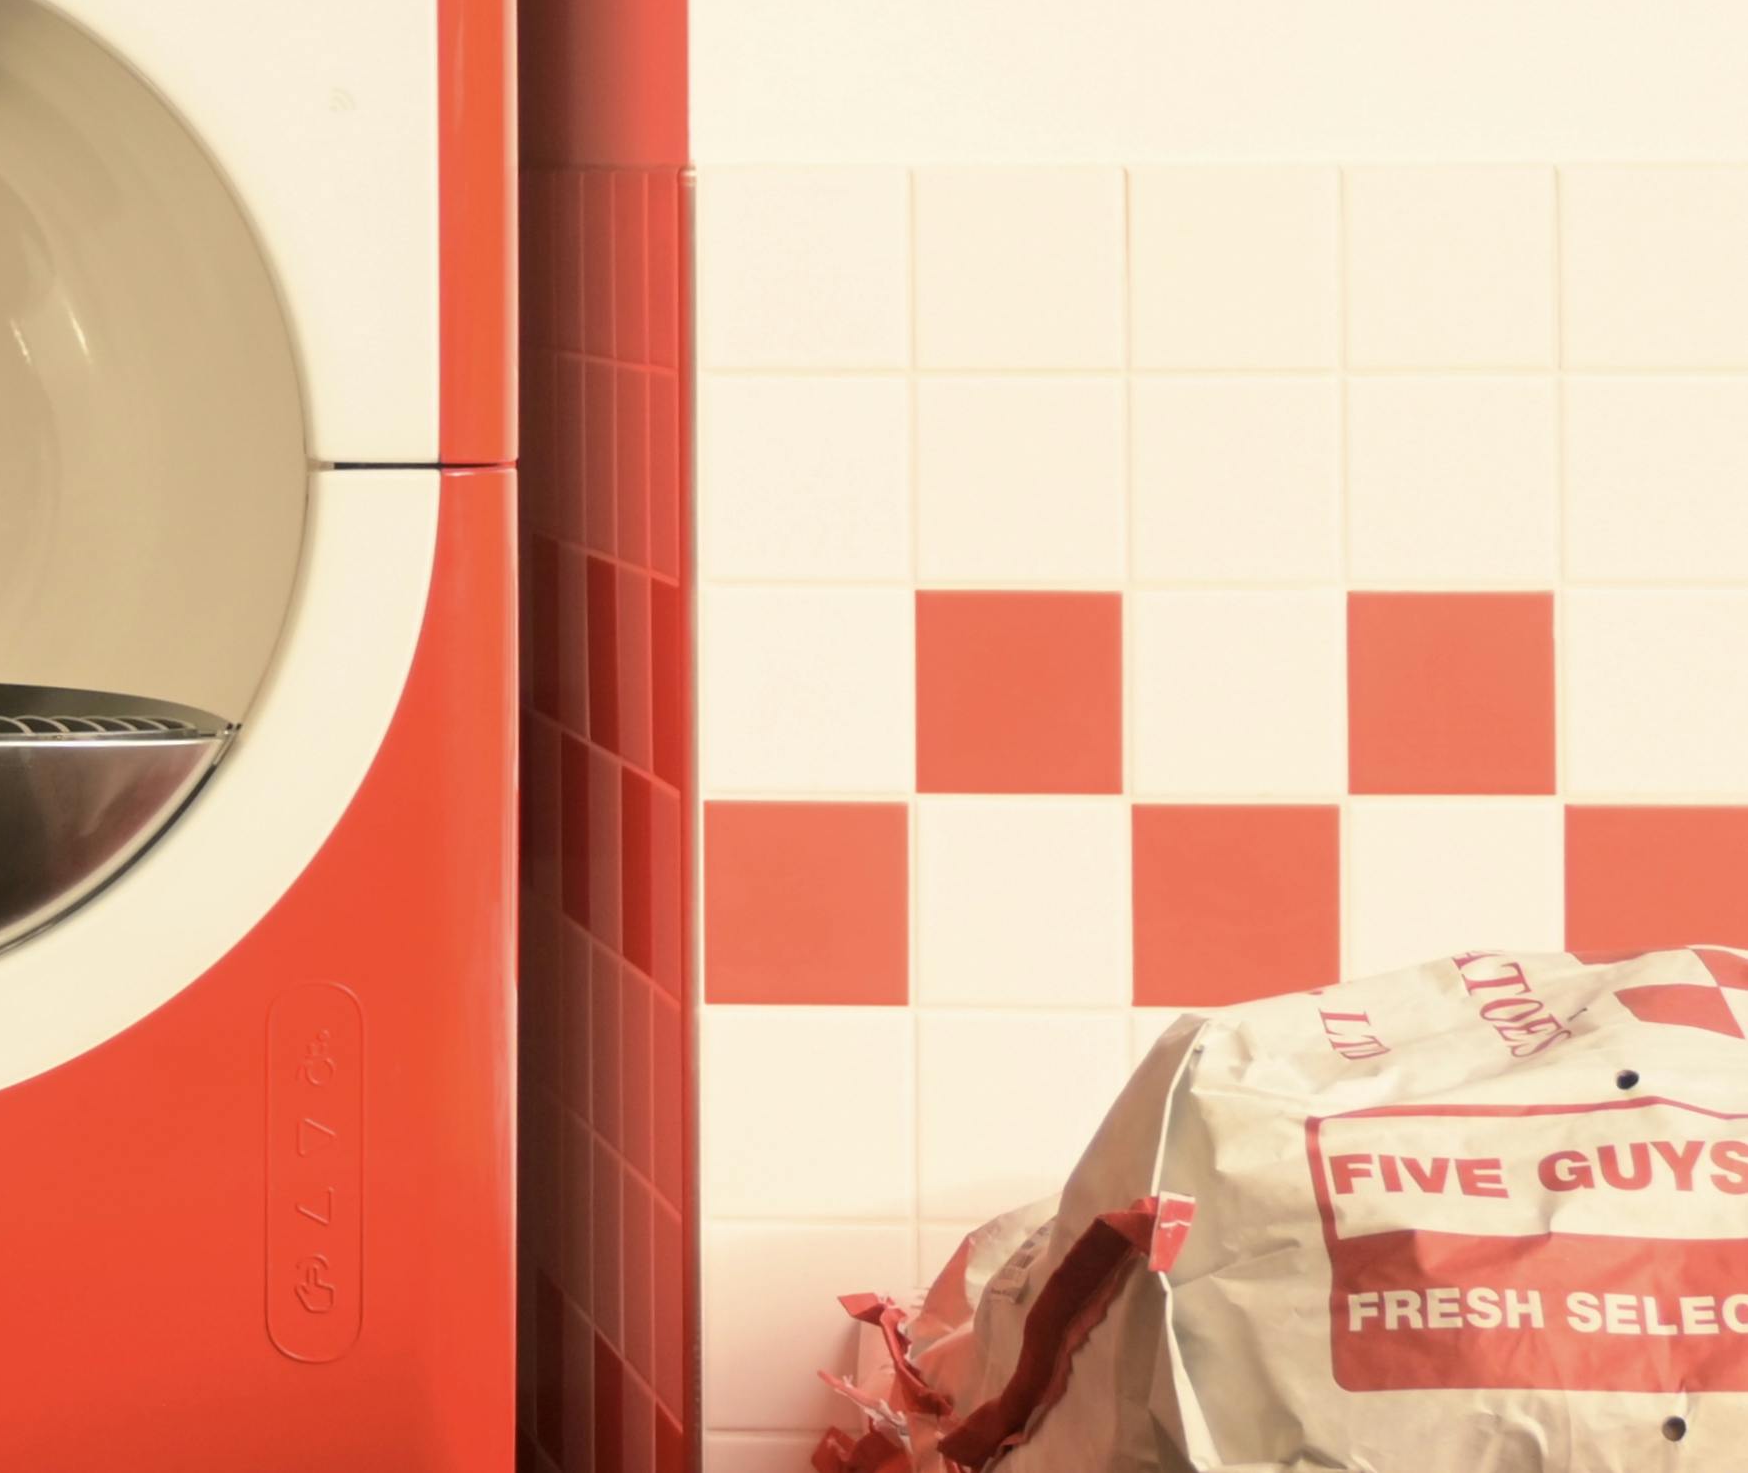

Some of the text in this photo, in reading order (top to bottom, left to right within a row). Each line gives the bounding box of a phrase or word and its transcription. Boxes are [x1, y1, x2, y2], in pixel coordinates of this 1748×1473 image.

[1328, 1139, 1748, 1198] FIVE GUYS
[1347, 1287, 1748, 1336] FRESH SELEC
